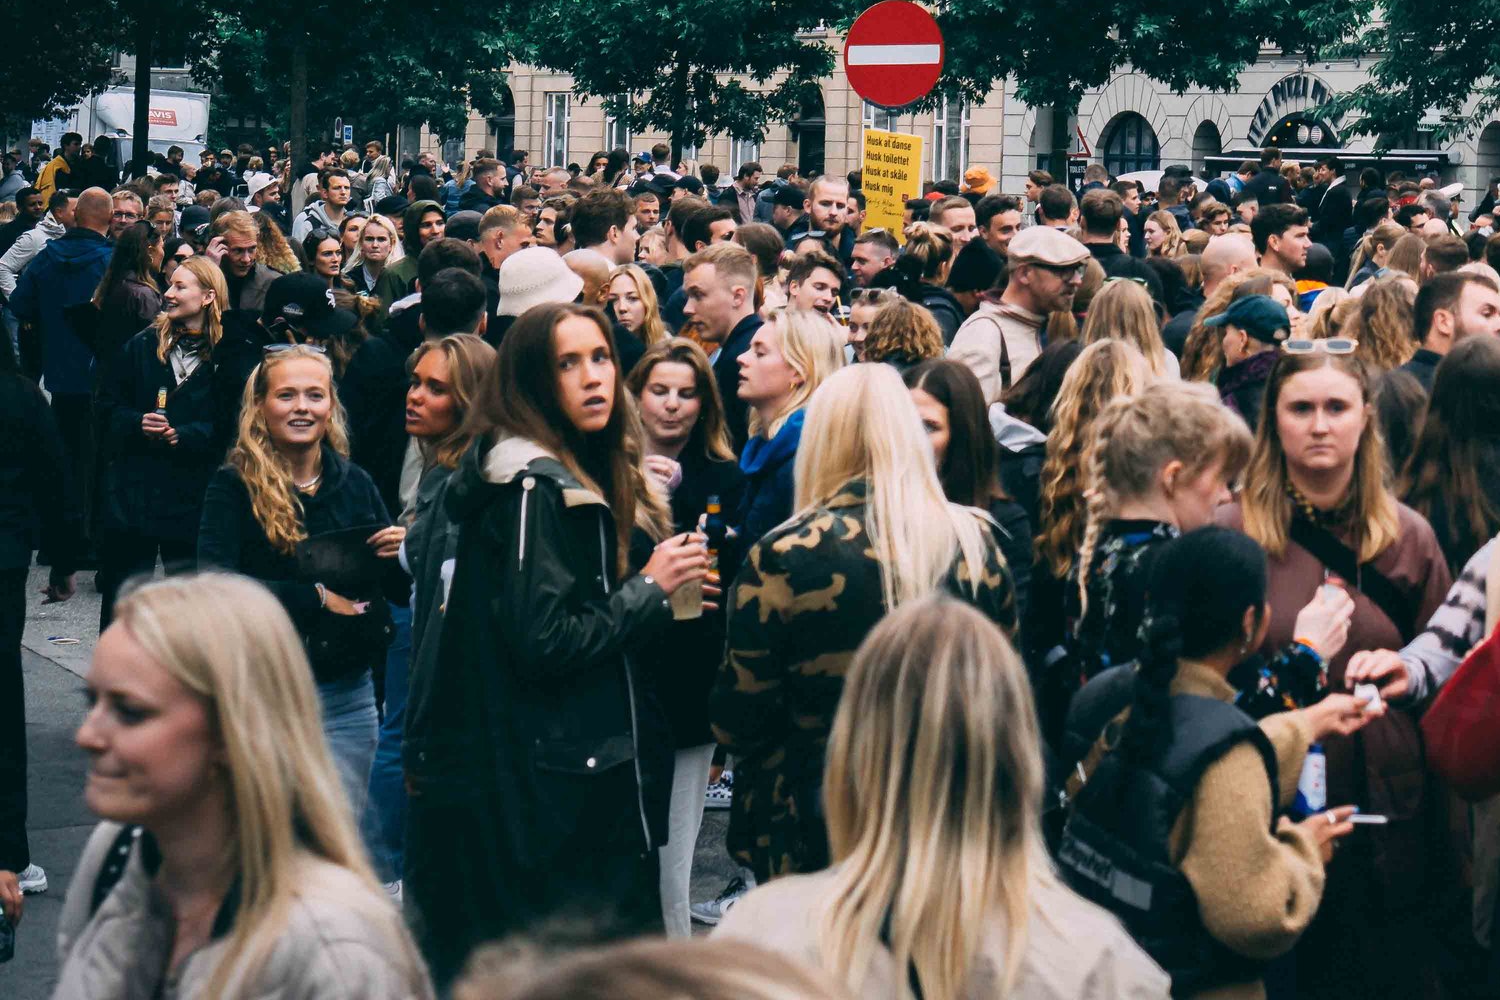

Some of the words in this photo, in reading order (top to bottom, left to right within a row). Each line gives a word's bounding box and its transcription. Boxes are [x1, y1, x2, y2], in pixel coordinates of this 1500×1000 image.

[149, 110, 171, 119] AVIS
[867, 135, 882, 147] Husk
[884, 139, 891, 148] at
[892, 139, 911, 151] danse
[866, 150, 881, 162] Husk
[883, 153, 909, 166] toilettet
[866, 165, 881, 176] Husk
[882, 169, 889, 178] at
[890, 169, 907, 181] skåle
[865, 180, 880, 191] Husk
[882, 184, 893, 196] mig
